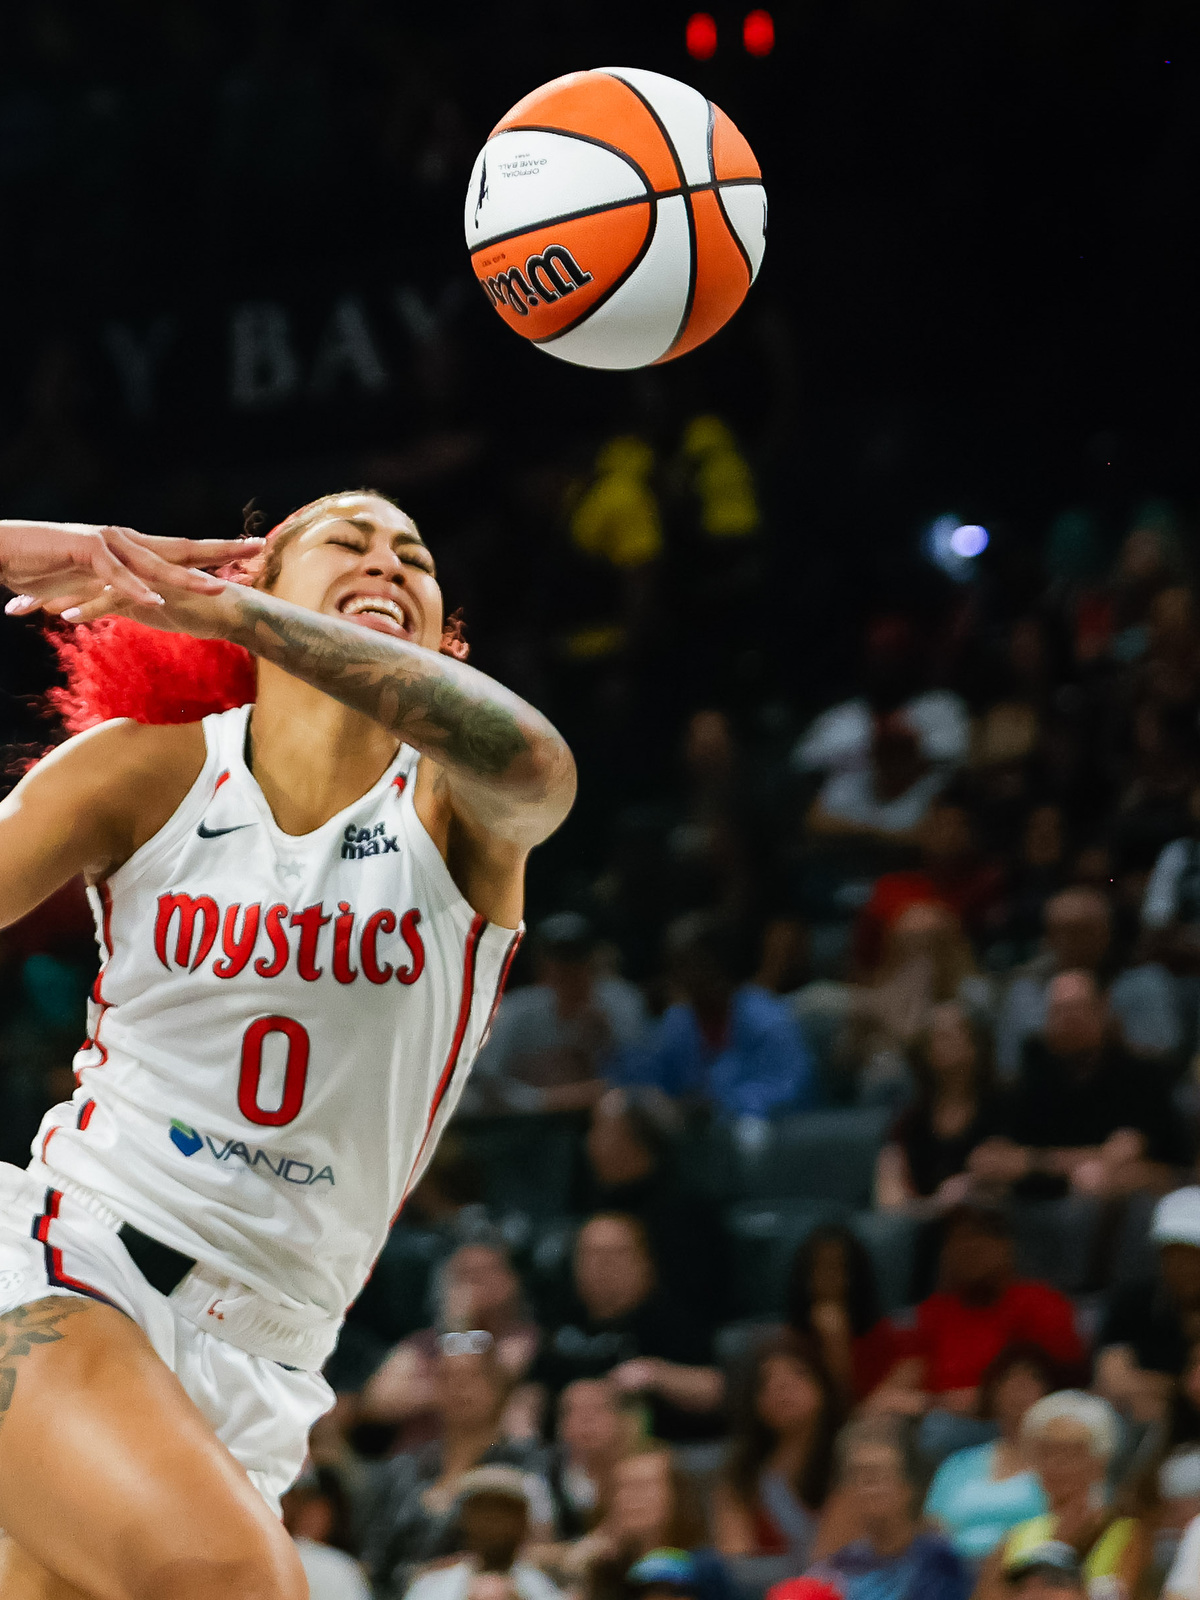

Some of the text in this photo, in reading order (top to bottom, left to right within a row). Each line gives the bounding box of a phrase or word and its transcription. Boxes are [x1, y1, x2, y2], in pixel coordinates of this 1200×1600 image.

[497, 158, 548, 171] GAME BALL
[501, 167, 540, 178] OFFICIAL
[228, 283, 463, 405] BAY
[344, 821, 385, 843] CAR
[341, 835, 400, 859] max
[237, 1015, 310, 1127] 0
[205, 1134, 335, 1186] VANDA
